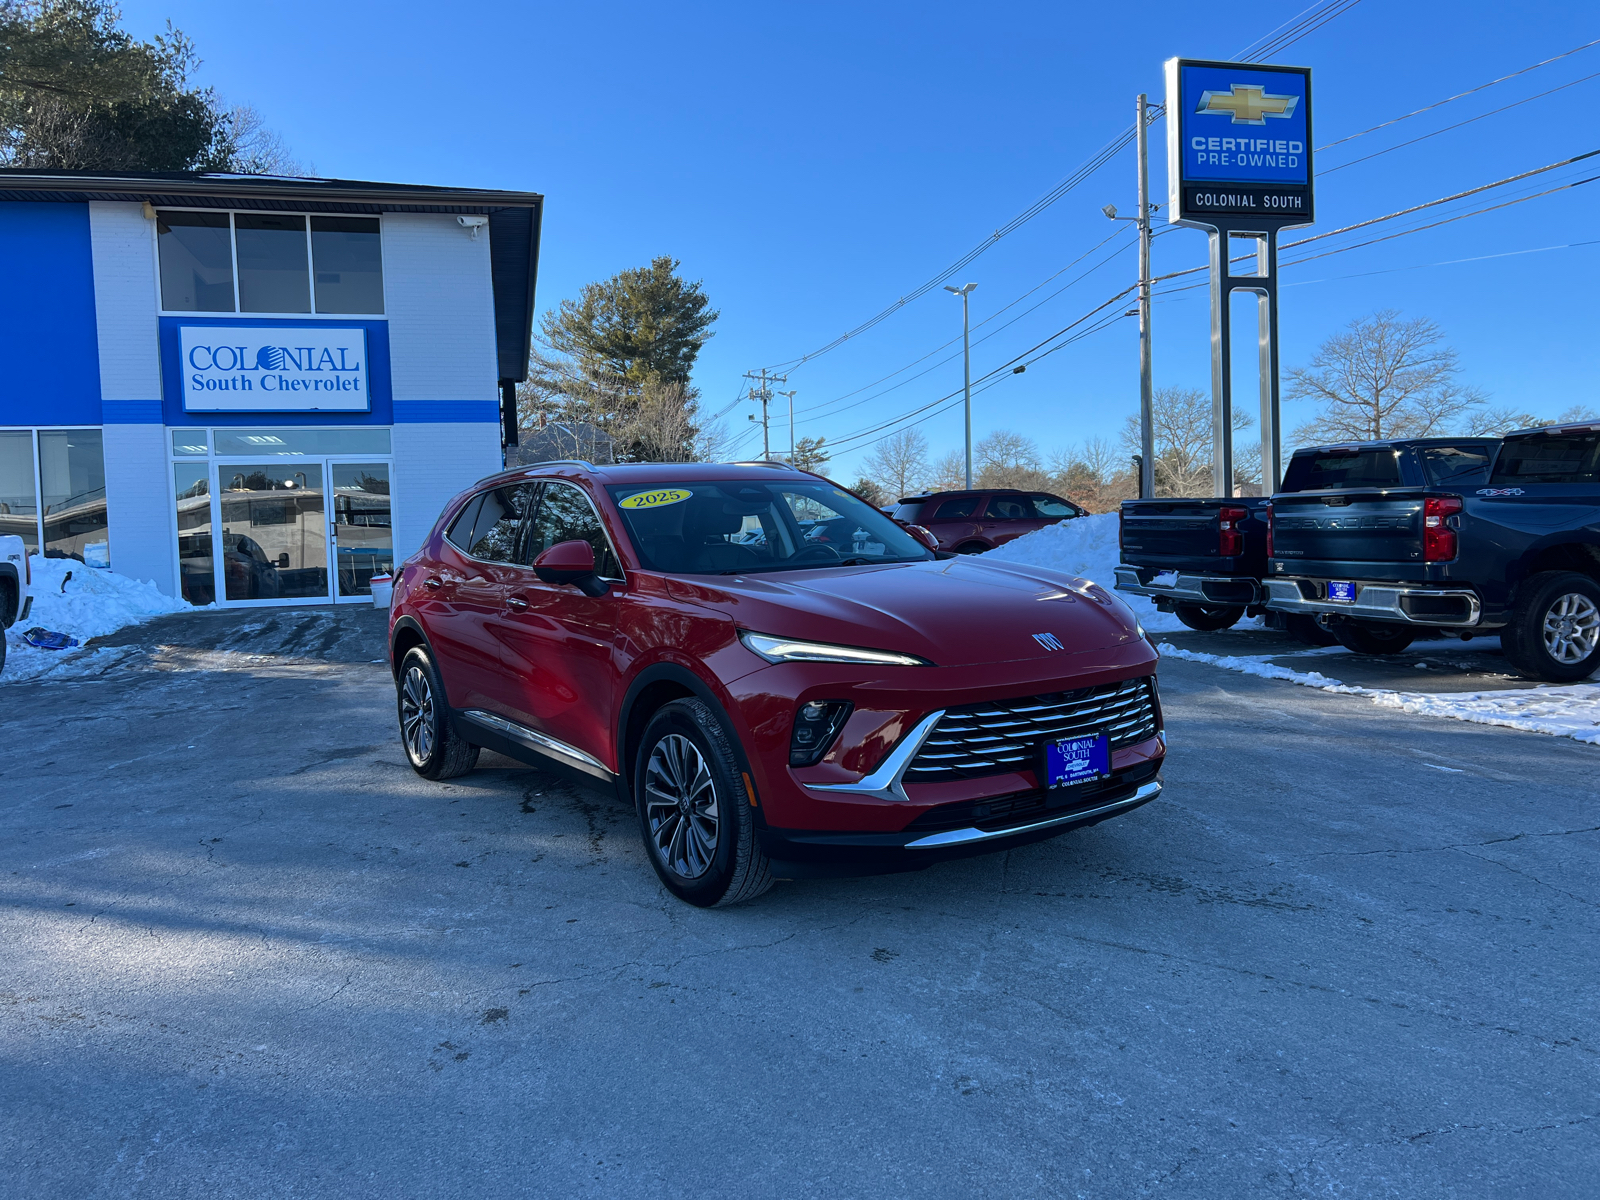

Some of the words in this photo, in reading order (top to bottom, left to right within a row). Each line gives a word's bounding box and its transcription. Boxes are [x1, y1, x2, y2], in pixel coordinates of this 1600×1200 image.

[1191, 136, 1303, 154] CERTIFIED
[1197, 152, 1298, 168] PRE-OWNED
[1195, 193, 1257, 207] COLONIAL
[1263, 195, 1302, 208] SOUTH
[189, 345, 360, 371] COLONIAL
[192, 373, 253, 392] South
[260, 373, 360, 392] Chevrolet
[633, 490, 681, 507] 2025
[1057, 739, 1095, 753] COLONIAL
[1063, 749, 1090, 761] SOUTH
